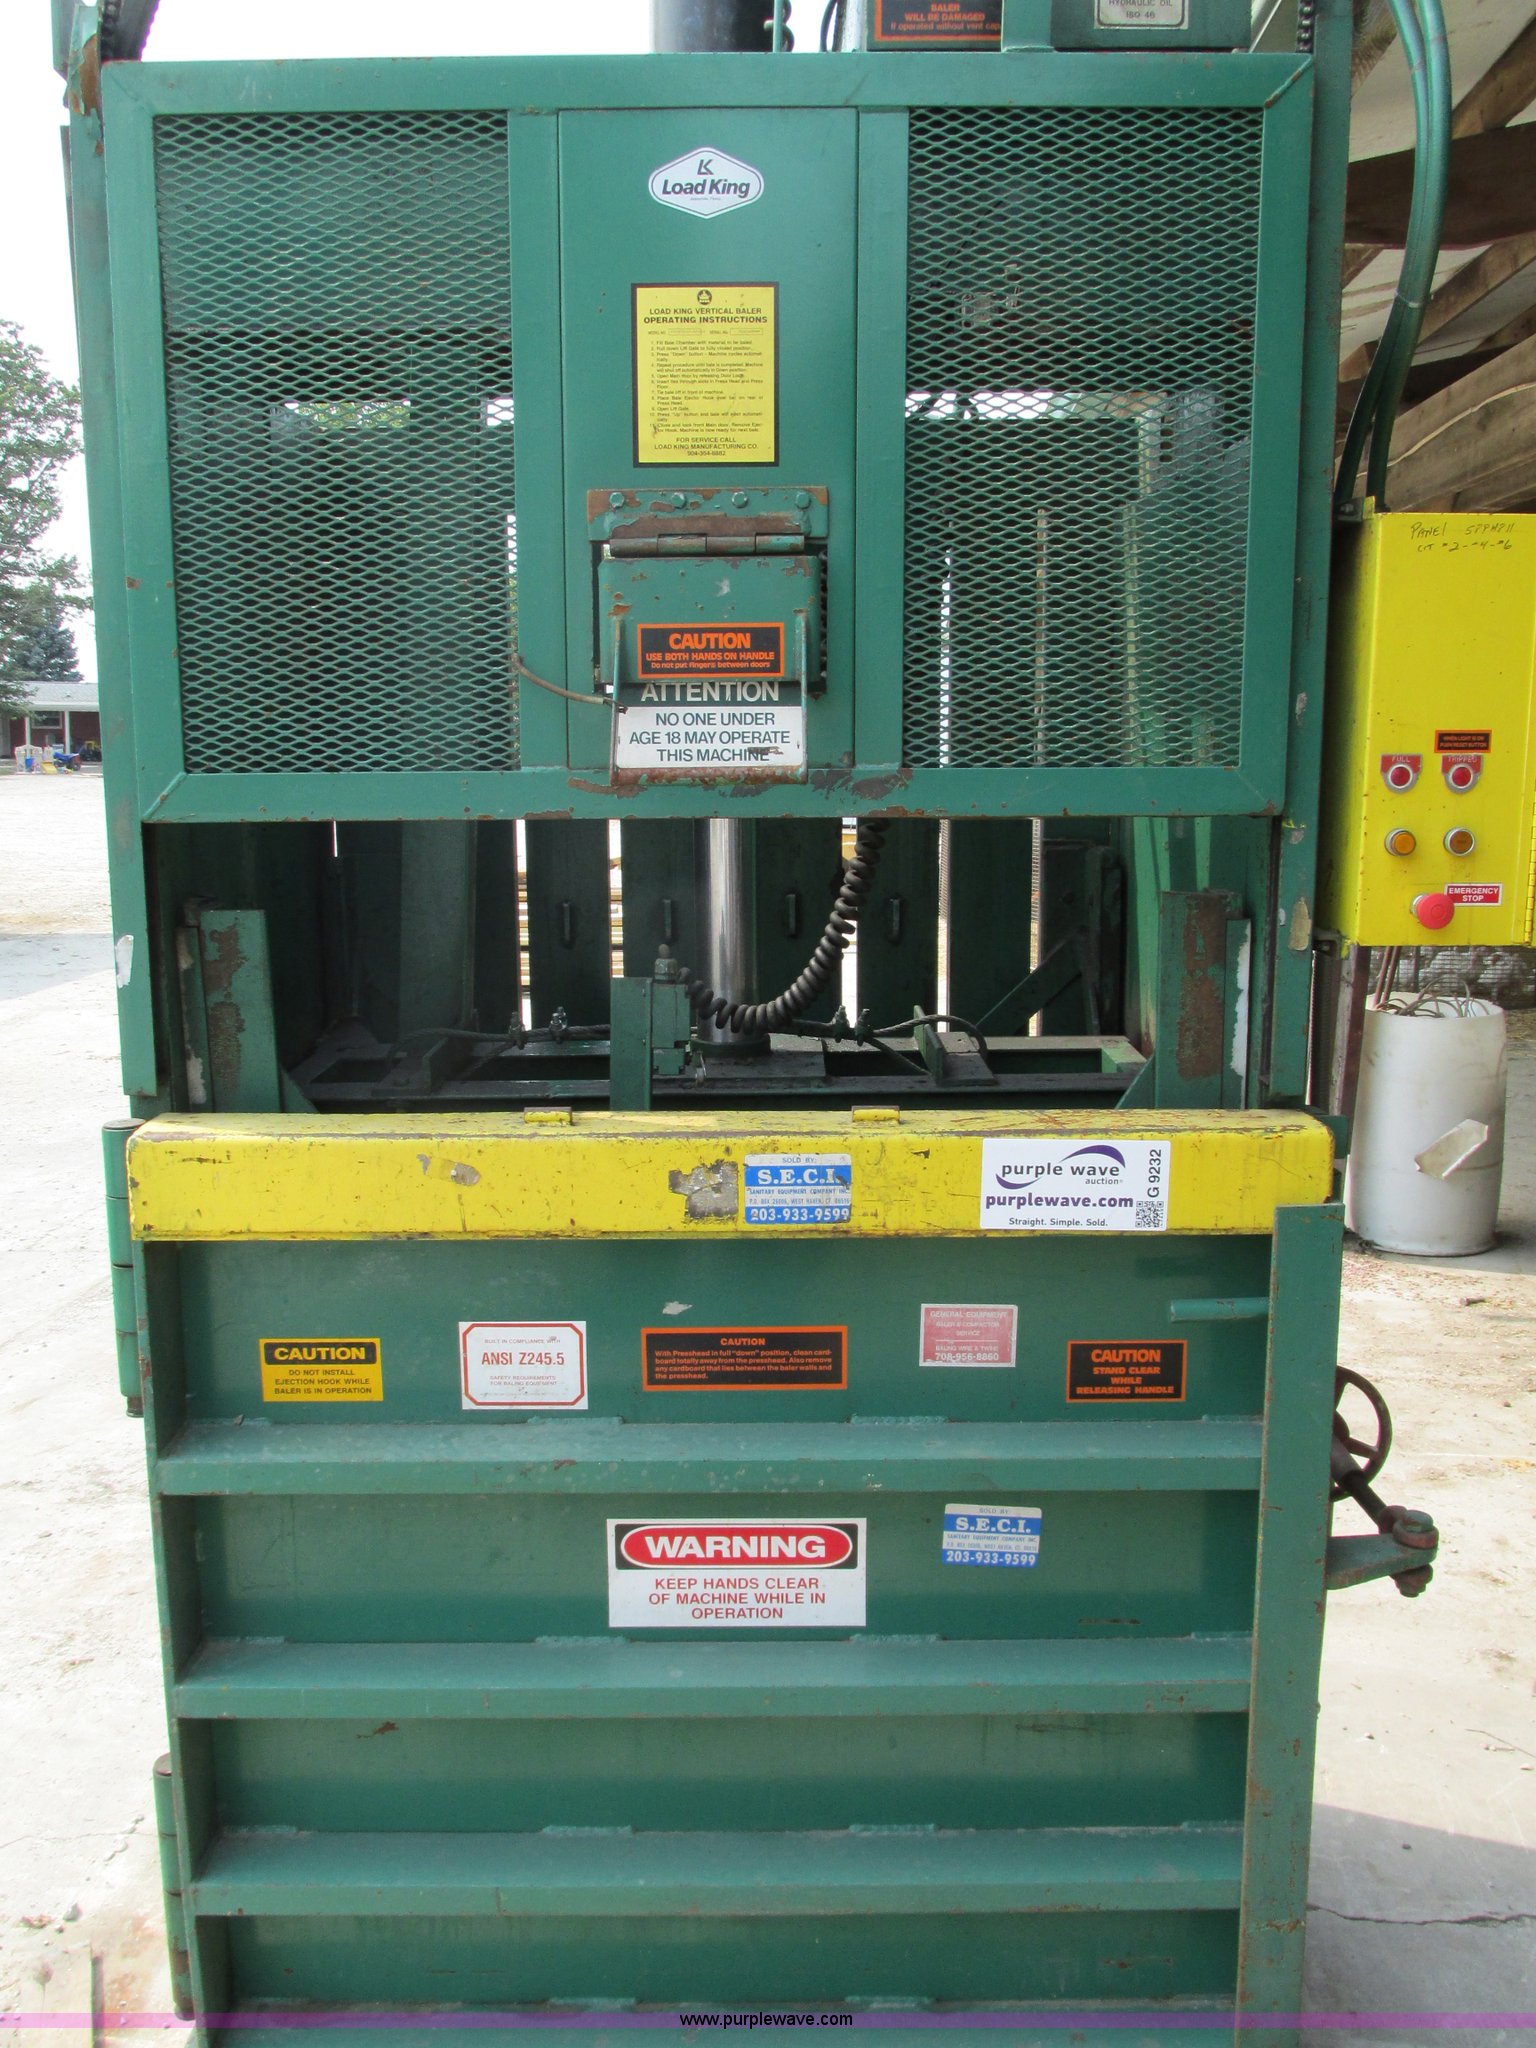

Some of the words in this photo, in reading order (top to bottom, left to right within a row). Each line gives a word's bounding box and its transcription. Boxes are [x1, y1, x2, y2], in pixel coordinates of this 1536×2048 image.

[931, 3, 960, 11] BALER
[905, 13, 926, 21] WILL
[928, 13, 940, 21] BE
[942, 13, 985, 21] DAMAGED
[662, 179, 707, 195] Load
[708, 179, 751, 199] King
[644, 316, 696, 324] OPERATING
[700, 316, 768, 324] INSTRUCTIONS
[669, 633, 750, 650] CAUTION
[692, 652, 722, 660] HANDS
[724, 652, 736, 660] ON
[739, 652, 774, 660] HANDLE
[641, 682, 779, 702] ATTENTION
[656, 712, 679, 726] NO
[683, 712, 716, 726] ONE
[720, 712, 775, 726] UNDER
[629, 732, 660, 745] AGE
[665, 732, 681, 744] 18
[684, 731, 720, 744] MAY
[720, 731, 790, 744] OPERATE
[657, 749, 693, 762] THIS
[696, 749, 770, 762] MACHINE
[1002, 1163, 1063, 1178] purple
[1070, 1166, 1119, 1176] wave
[1149, 1149, 1162, 1183] 9232
[1148, 1187, 1159, 1198] G
[986, 1193, 1133, 1210] purplewave.com
[750, 1208, 850, 1221] 203-933-9599
[1009, 1218, 1047, 1227] Straight.
[1050, 1218, 1083, 1227] Simple.
[720, 1338, 766, 1346] CAUTION
[274, 1347, 365, 1360] CAUTION
[482, 1352, 512, 1365] ANSI
[519, 1352, 564, 1365] Z245.5
[1091, 1349, 1160, 1362] CAUTION
[1135, 1386, 1174, 1394] HANDLE
[956, 1517, 1031, 1534] S.E.C.I.
[644, 1536, 825, 1558] WARNING
[947, 1550, 1036, 1566] 203-933-9599
[655, 1578, 697, 1590] KEEP
[704, 1578, 759, 1590] HANDS
[765, 1578, 819, 1590] CLEAR
[648, 1593, 670, 1604] OF
[676, 1593, 748, 1604] MACHINE
[754, 1593, 804, 1604] WHILE
[811, 1593, 825, 1604] IN
[692, 1608, 783, 1619] OPERATION
